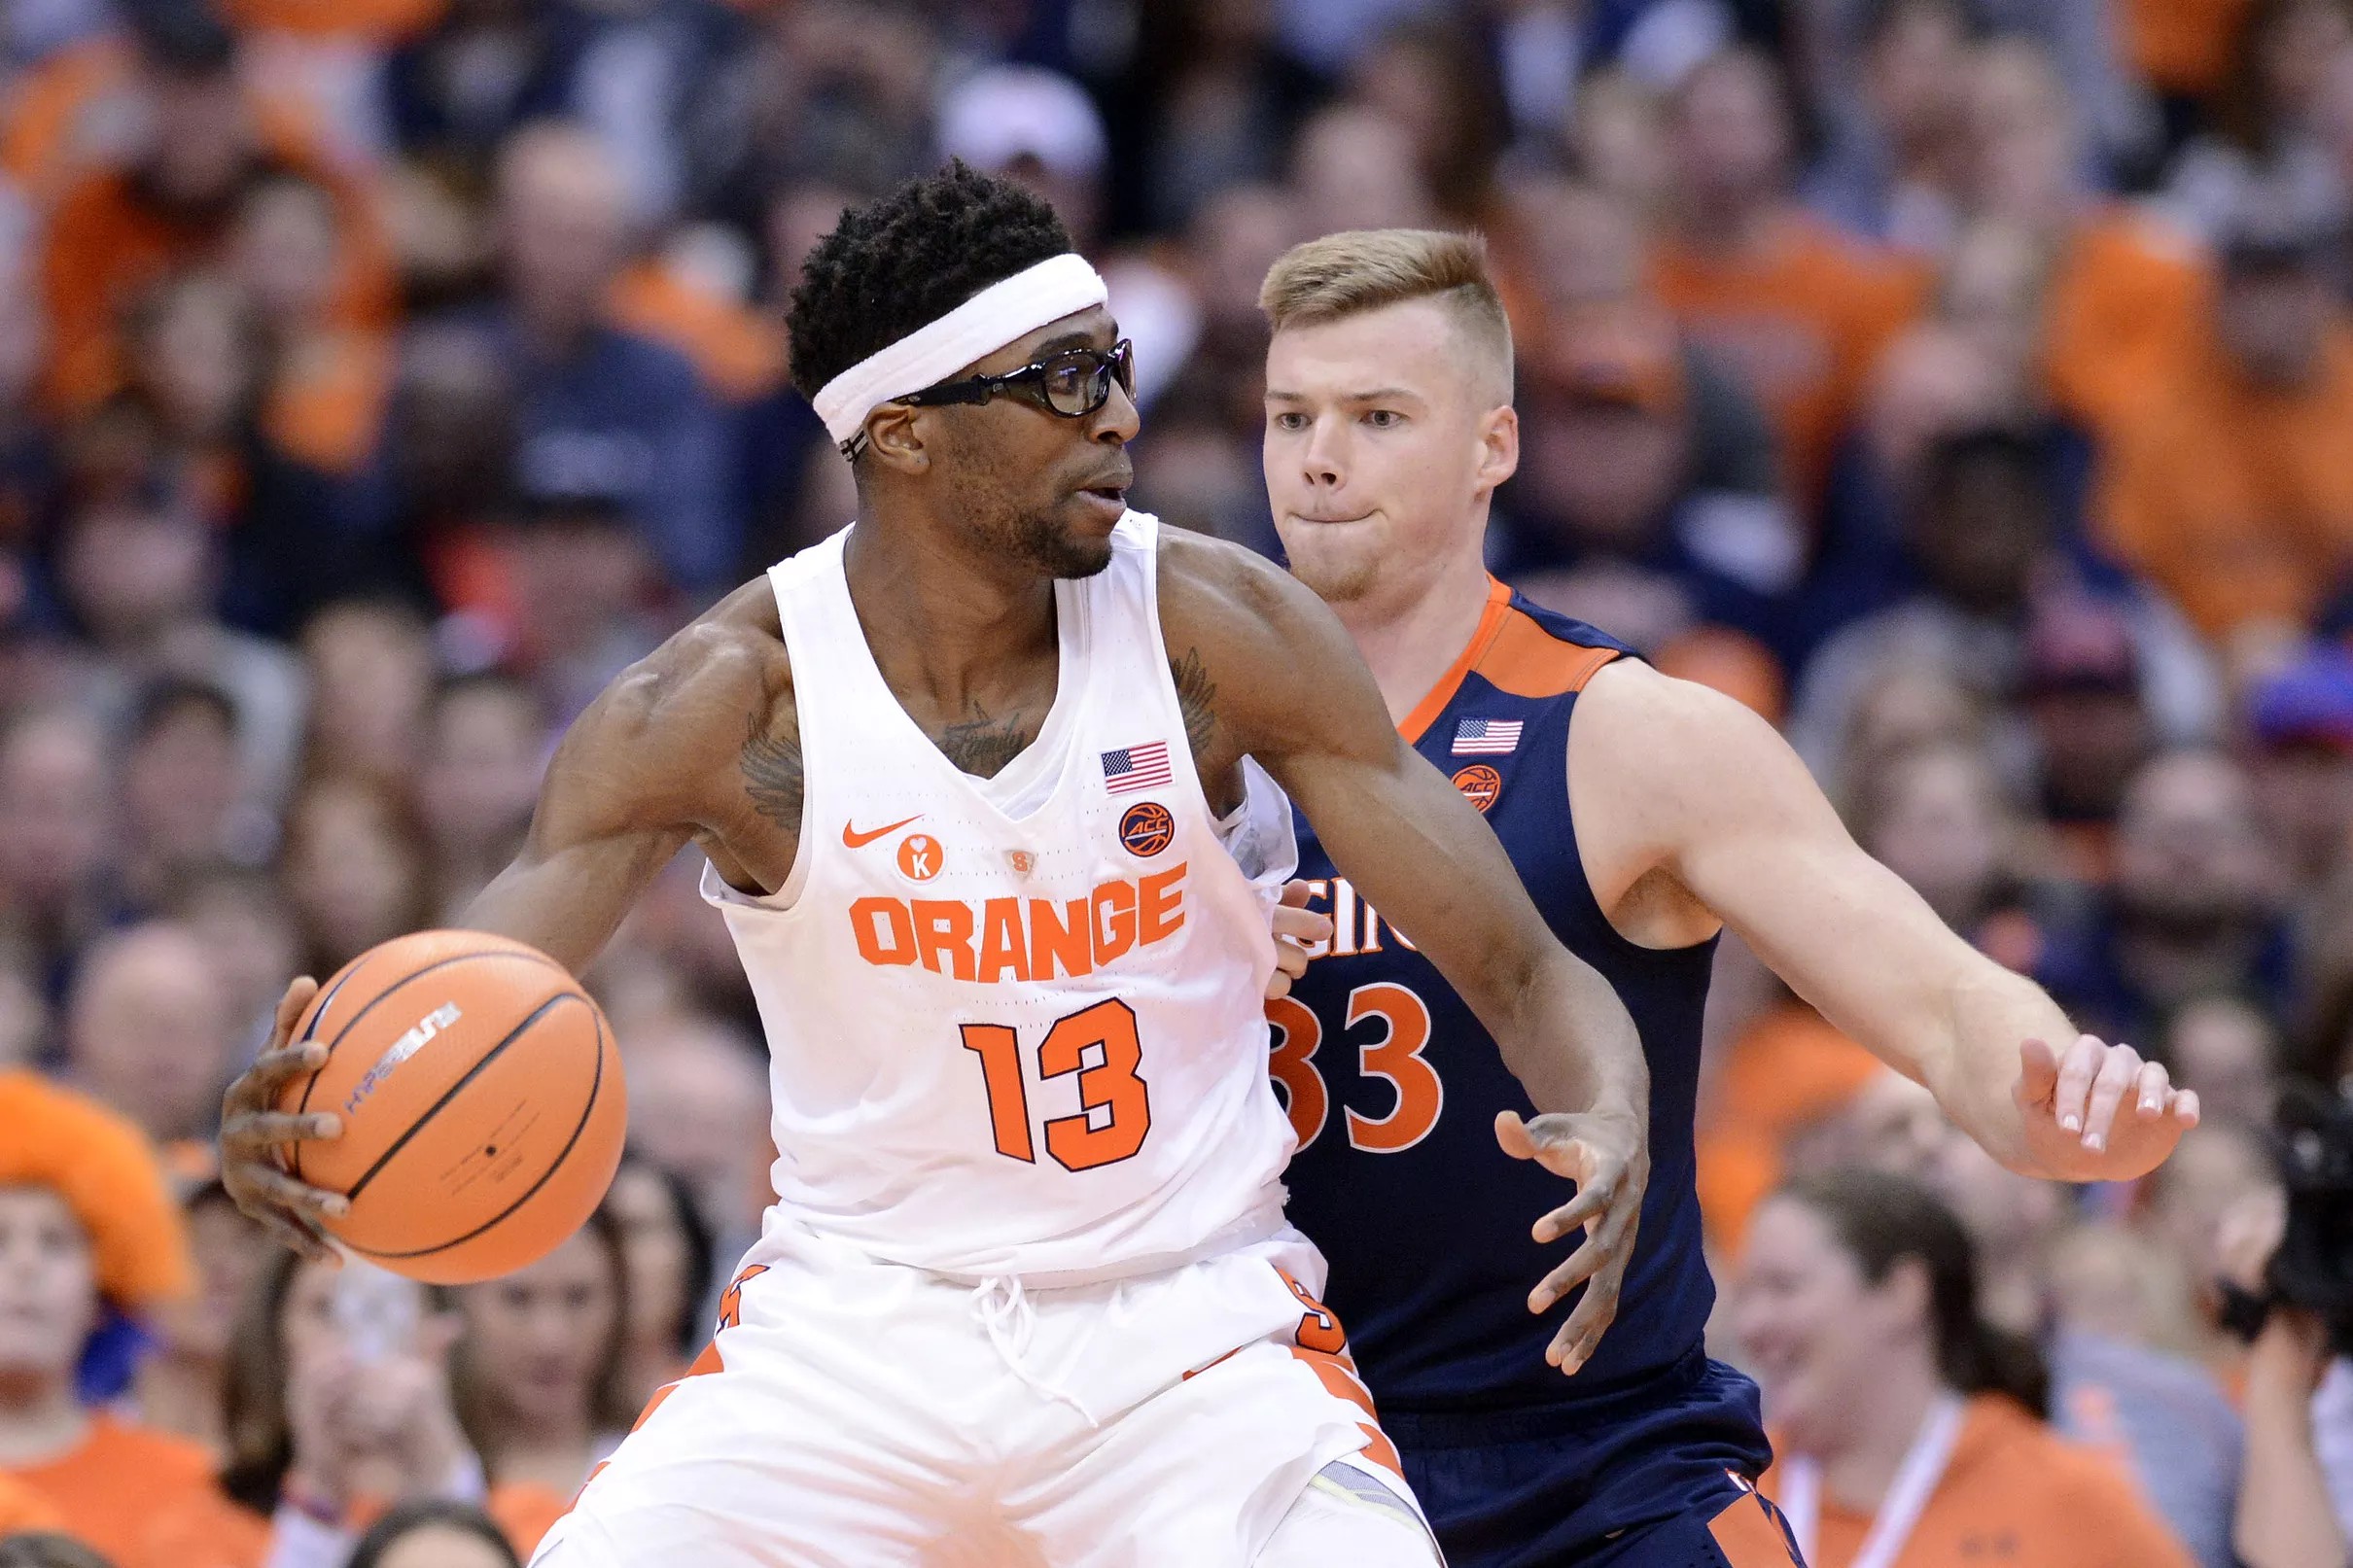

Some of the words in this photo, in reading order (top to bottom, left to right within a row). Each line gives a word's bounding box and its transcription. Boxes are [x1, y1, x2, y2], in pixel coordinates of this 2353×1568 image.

[1459, 782, 1495, 793] ACC
[1128, 817, 1169, 836] ACC
[912, 853, 931, 878] K
[849, 861, 1187, 984] ORANGE
[959, 996, 1151, 1172] 13
[1264, 982, 1444, 1155] 33
